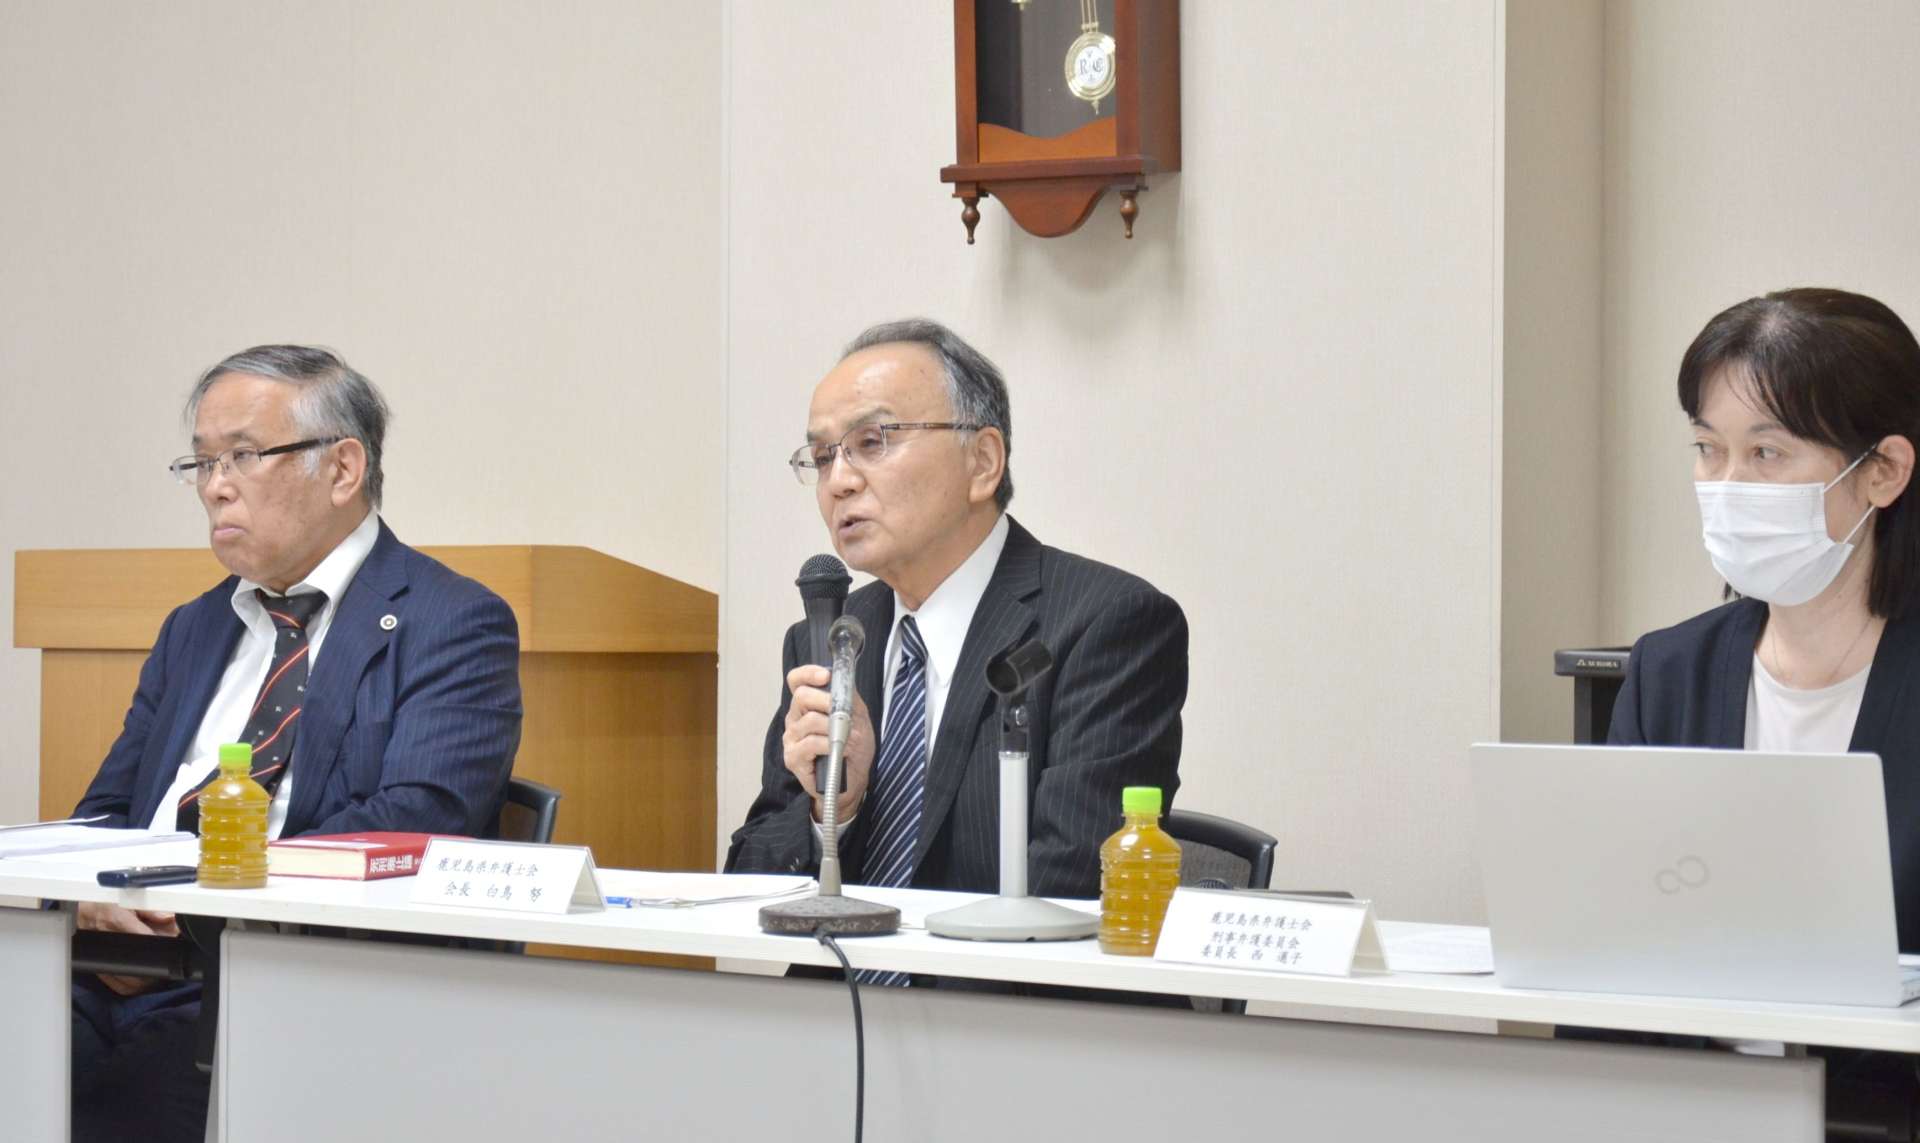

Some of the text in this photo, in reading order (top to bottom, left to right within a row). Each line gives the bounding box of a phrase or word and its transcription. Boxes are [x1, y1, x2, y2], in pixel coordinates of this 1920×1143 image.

[438, 857, 538, 877] 鹿児島県弁護士会
[444, 881, 472, 897] 会長
[1211, 911, 1313, 931] 鹿児島県弁護士会
[1211, 931, 1301, 949] 刑事弁護委員会
[1201, 944, 1237, 959] 委員長
